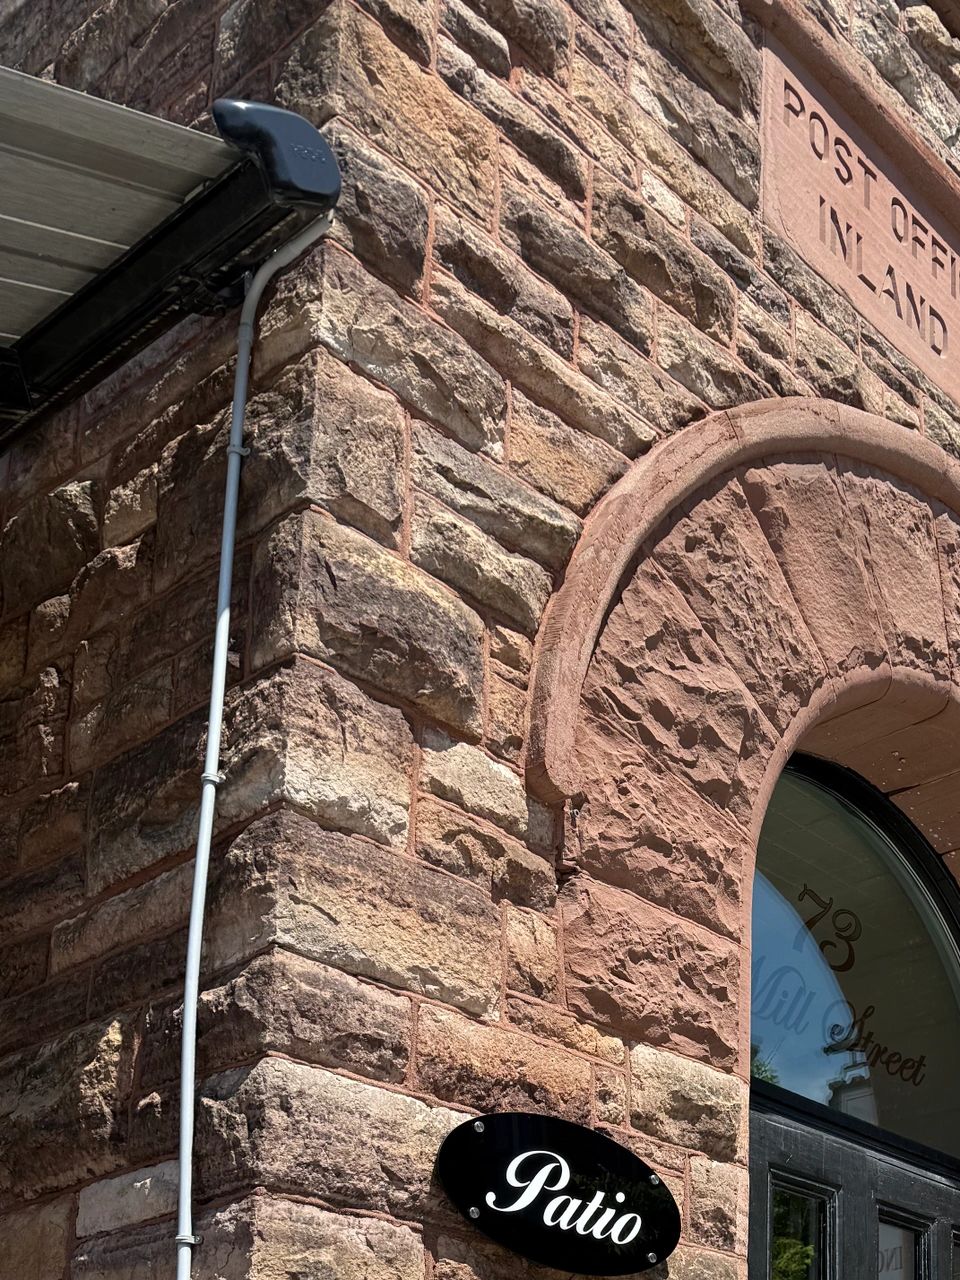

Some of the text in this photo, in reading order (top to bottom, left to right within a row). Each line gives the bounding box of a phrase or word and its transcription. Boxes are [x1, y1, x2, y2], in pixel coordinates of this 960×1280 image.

[783, 79, 877, 210] POST
[818, 194, 949, 359] INLAND
[792, 883, 862, 972] 73
[822, 999, 926, 1087] Street
[485, 1150, 642, 1245] Patio
